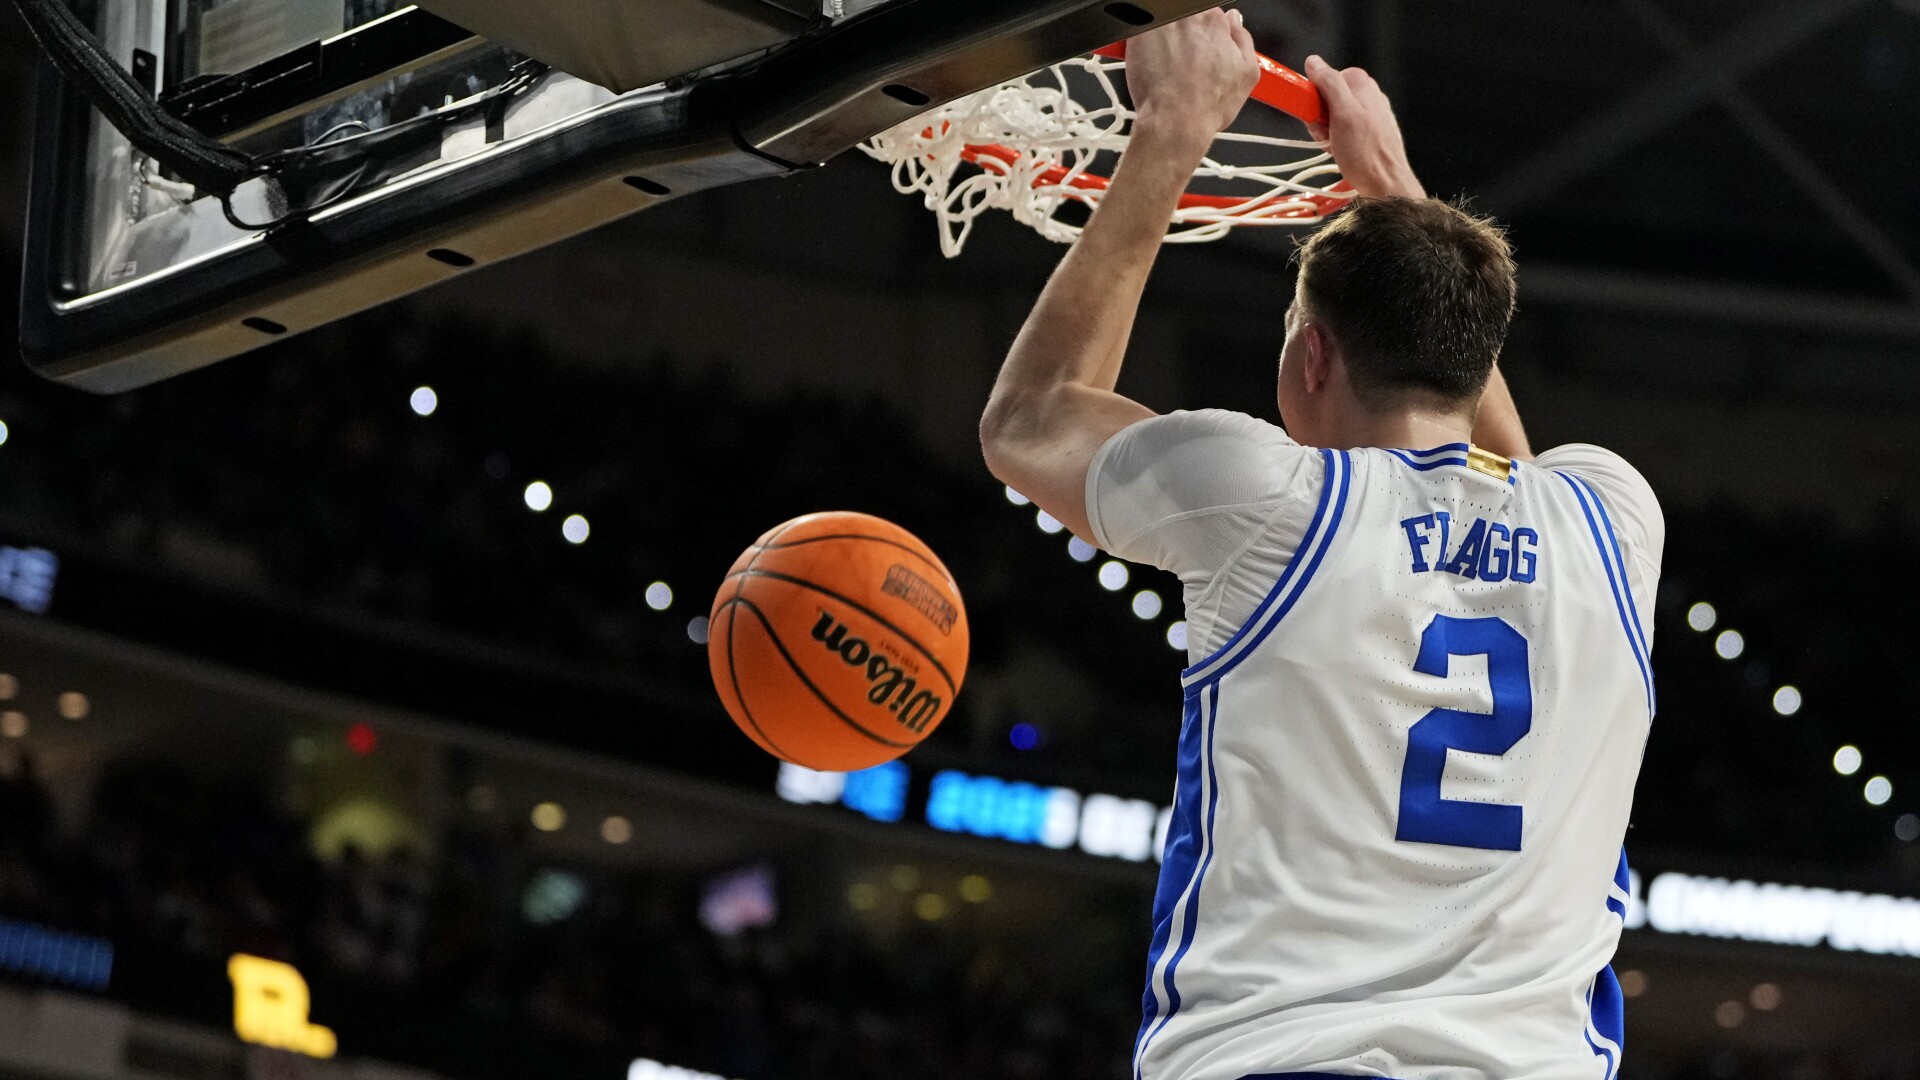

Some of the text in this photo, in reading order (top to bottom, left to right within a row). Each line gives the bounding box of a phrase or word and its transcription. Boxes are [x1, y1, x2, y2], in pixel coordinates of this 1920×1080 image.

[1400, 511, 1539, 584] FLAGG
[811, 609, 941, 734] Wilson
[1395, 613, 1533, 852] 2
